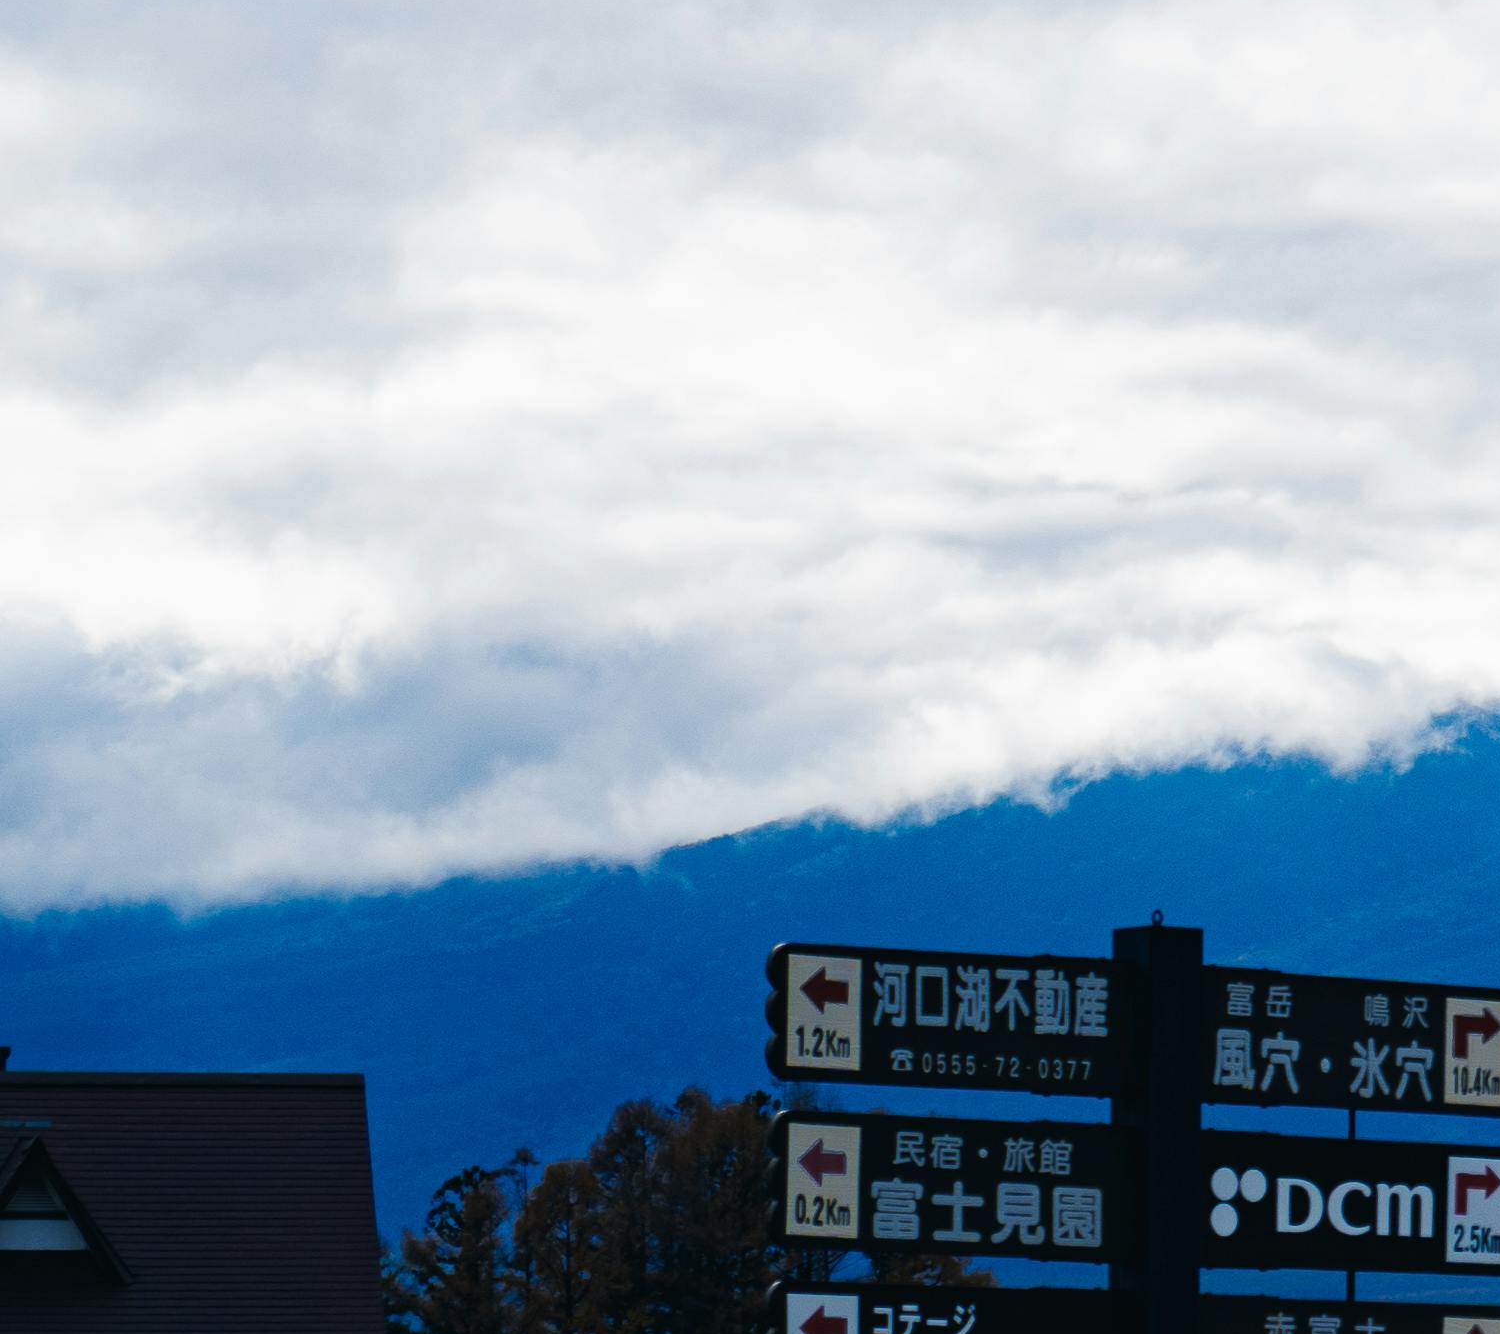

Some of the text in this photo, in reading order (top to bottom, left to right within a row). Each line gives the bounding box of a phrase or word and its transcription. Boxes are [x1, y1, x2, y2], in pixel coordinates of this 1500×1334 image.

[872, 960, 1108, 1037] 河口湖不動産
[1226, 982, 1430, 1029] 富岳 鳴沢
[795, 1027, 850, 1058] 1.2Km
[1212, 1027, 1434, 1102] 風穴・氷穴
[922, 1053, 1092, 1081] 0555-72-0377
[1452, 1067, 1500, 1097] 10.4Km
[893, 1130, 1073, 1175] 民宿・旅館
[794, 1194, 850, 1226] 0.2Km
[870, 1177, 1102, 1247] 富士見園
